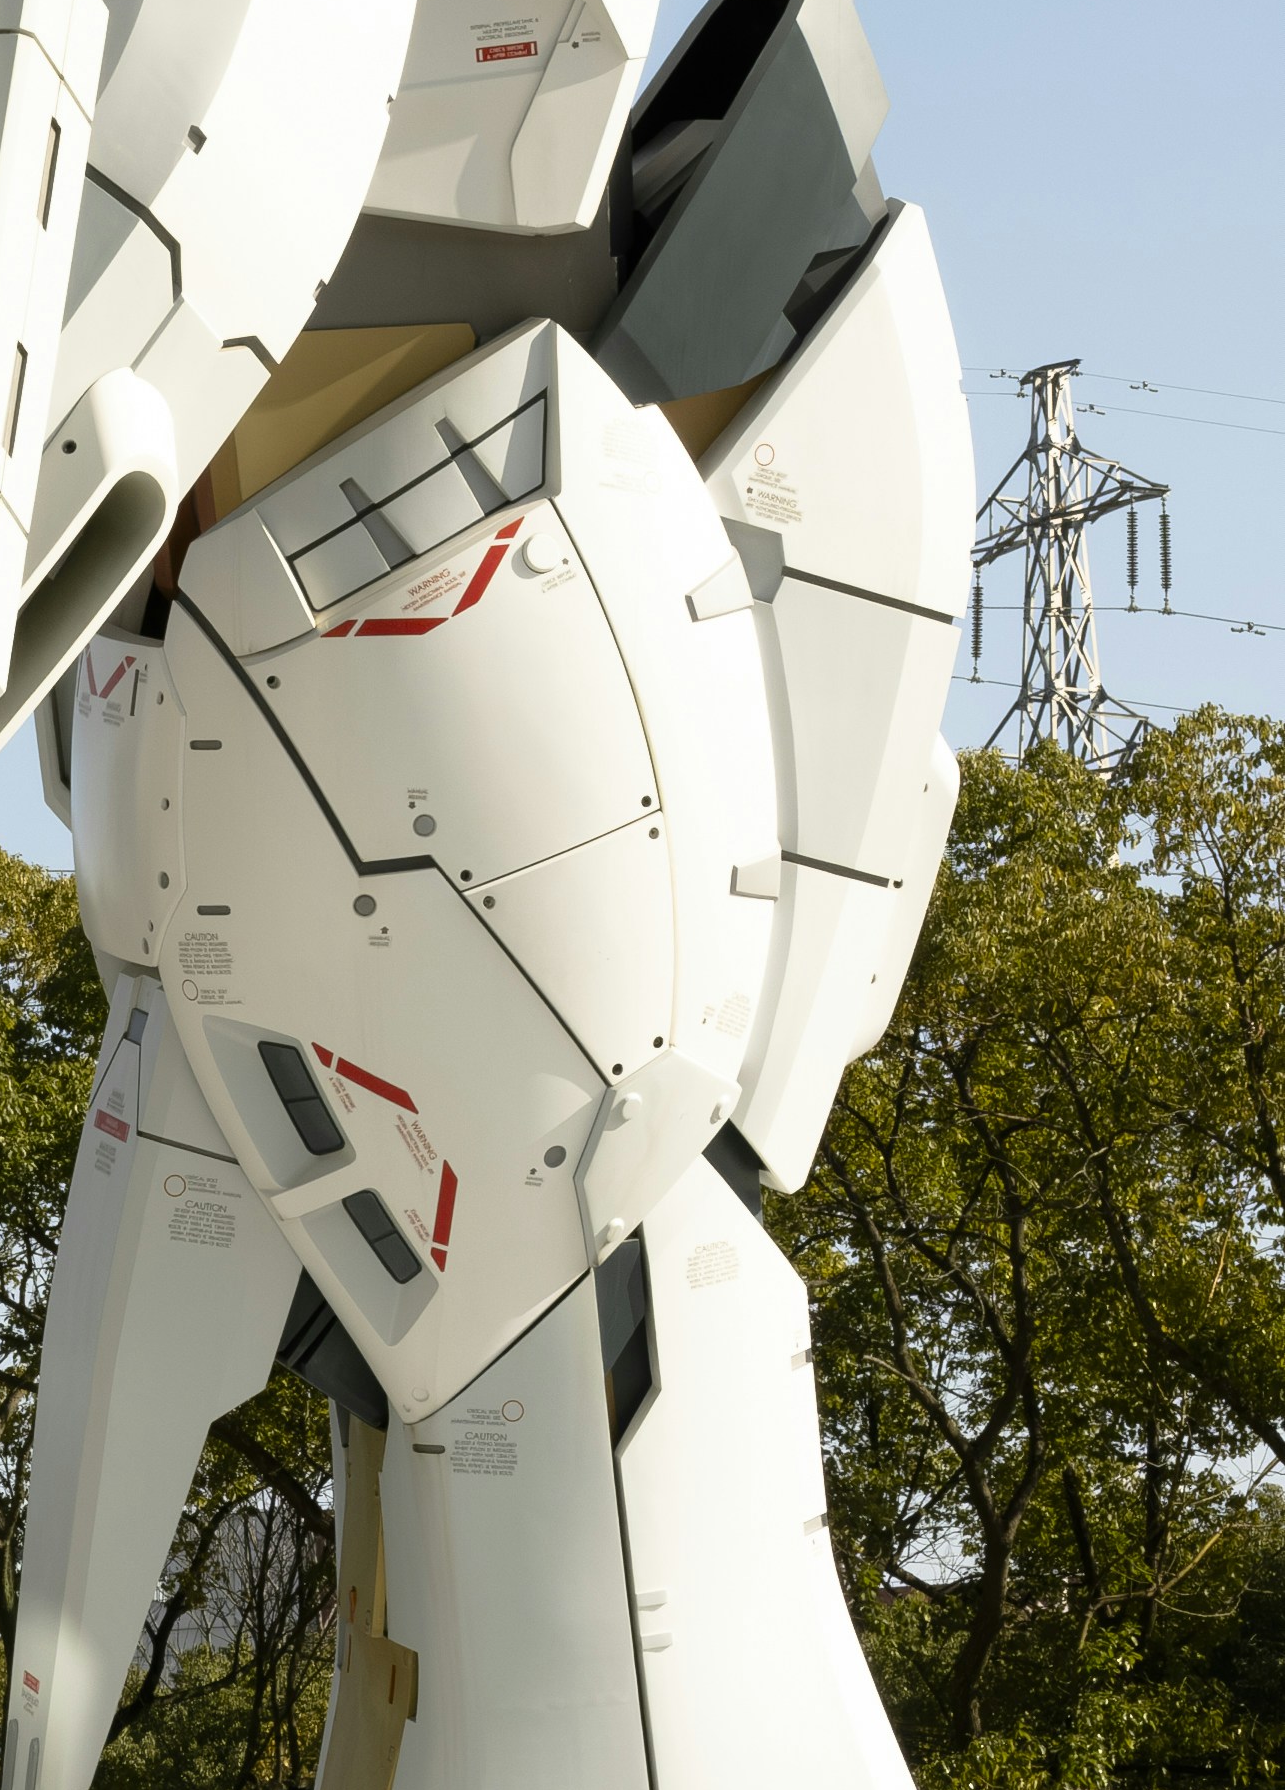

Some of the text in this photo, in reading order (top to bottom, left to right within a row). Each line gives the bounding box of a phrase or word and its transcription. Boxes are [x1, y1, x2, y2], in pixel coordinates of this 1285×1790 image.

[756, 489, 798, 508] WARNING
[406, 567, 451, 598] WARNING
[184, 932, 218, 941] CAUTION
[409, 1119, 439, 1162] WARNING
[184, 1199, 227, 1212] CAUTION
[464, 1431, 508, 1441] CAUTION
